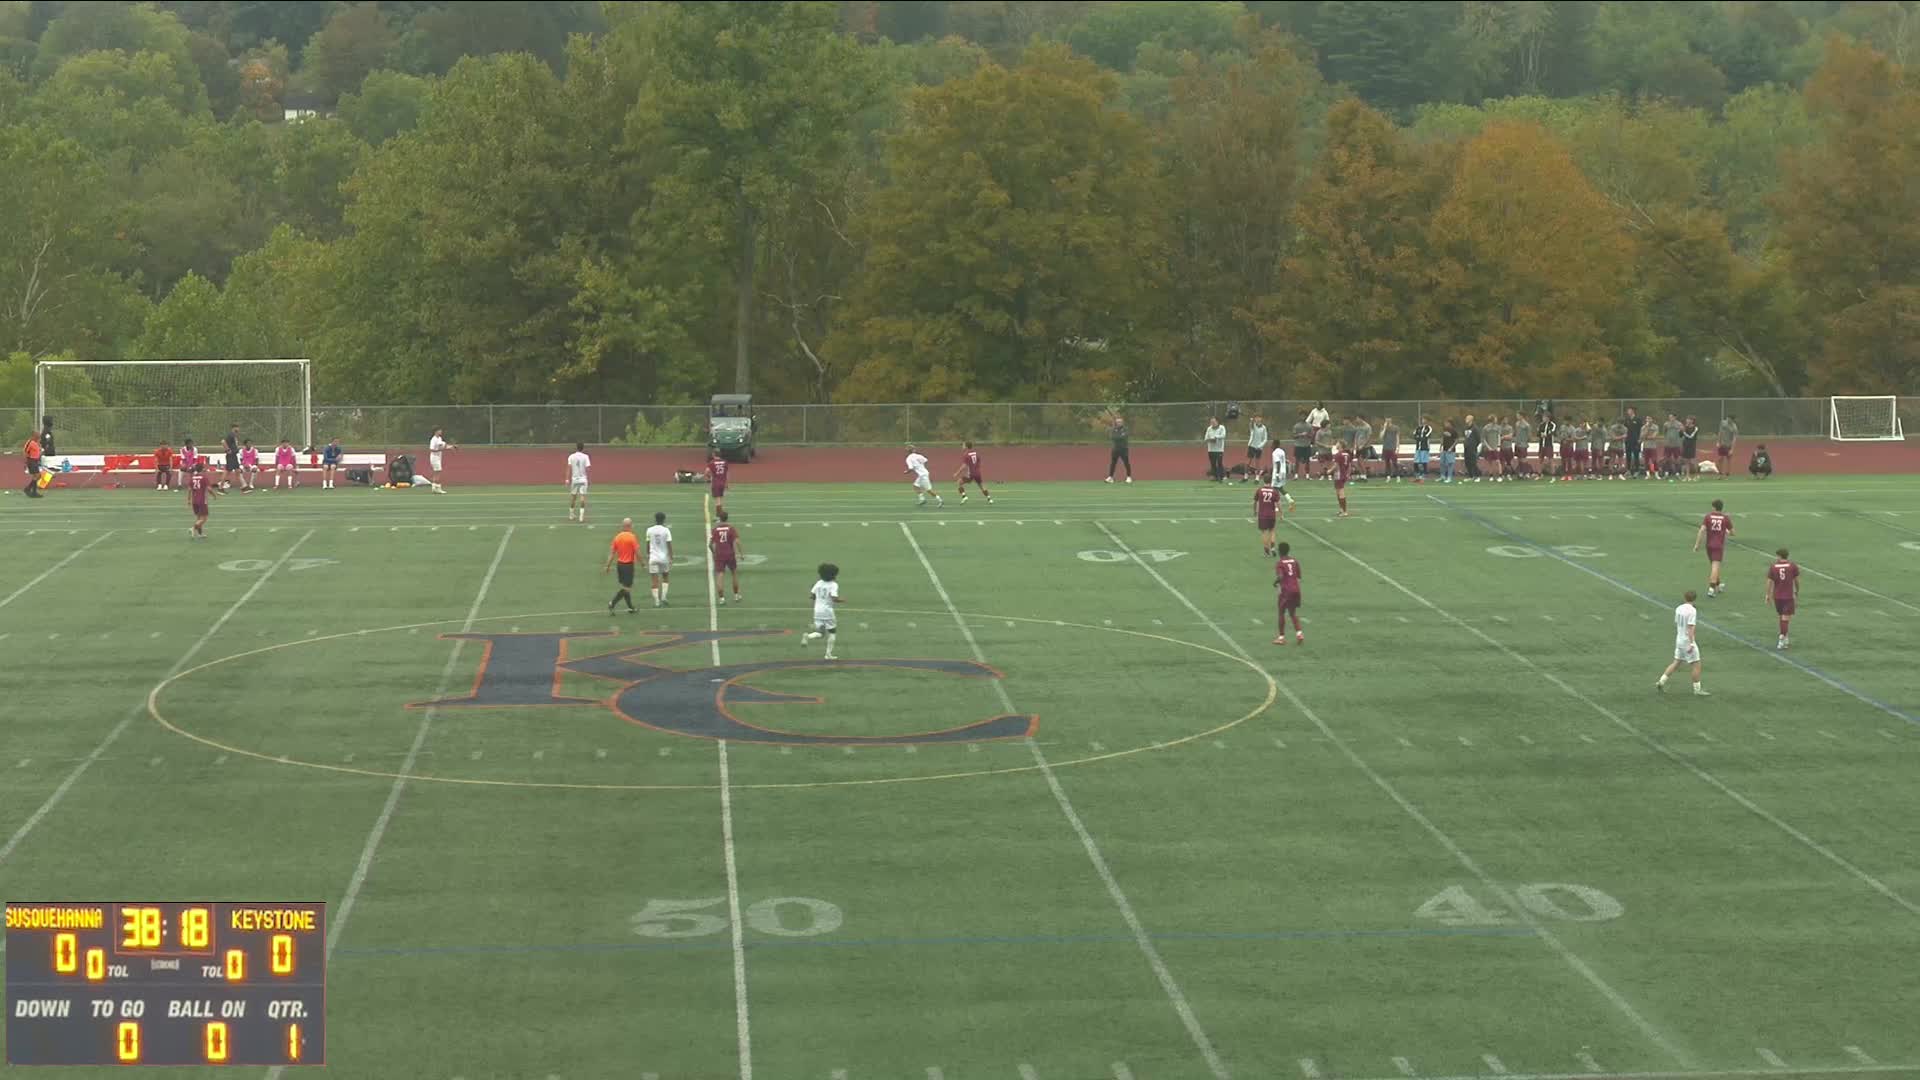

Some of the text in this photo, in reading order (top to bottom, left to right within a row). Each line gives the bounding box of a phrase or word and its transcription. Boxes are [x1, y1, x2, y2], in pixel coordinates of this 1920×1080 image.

[1262, 491, 1273, 503] 22
[1711, 519, 1722, 531] 23
[718, 530, 728, 543] 21
[1413, 882, 1625, 926] 40
[627, 896, 843, 938] 50
